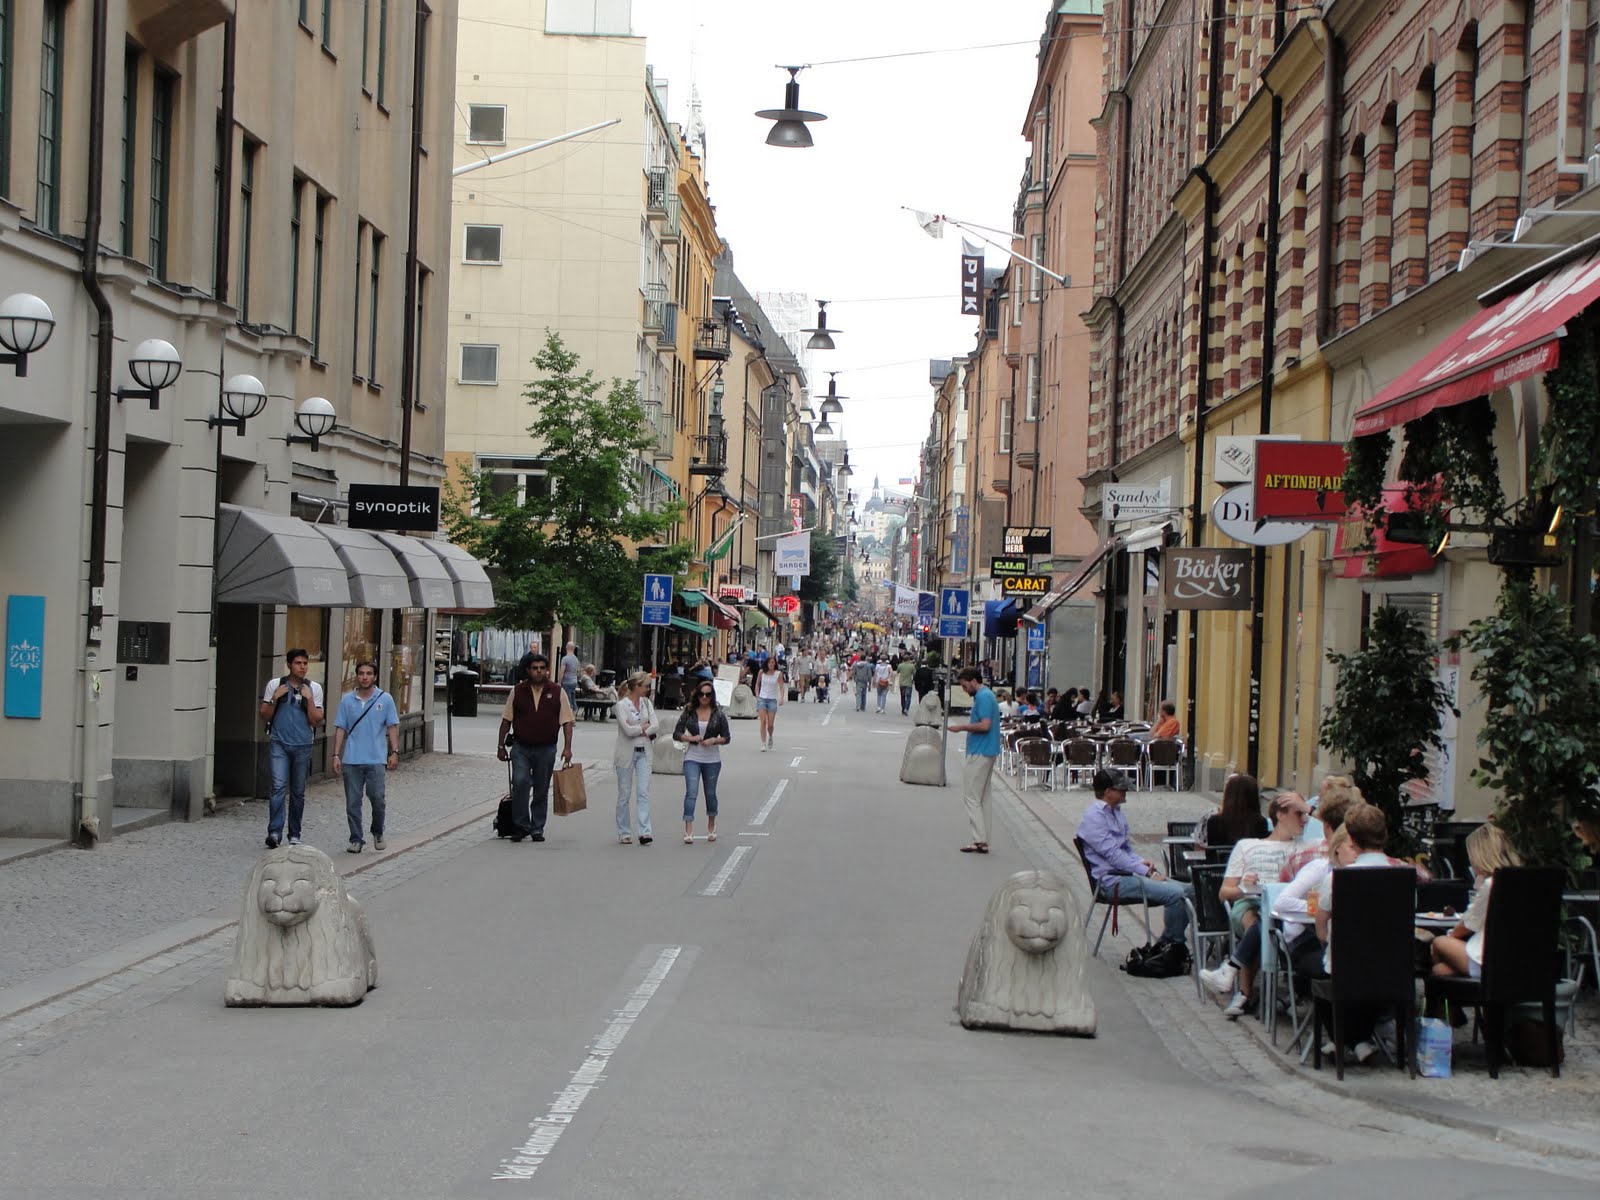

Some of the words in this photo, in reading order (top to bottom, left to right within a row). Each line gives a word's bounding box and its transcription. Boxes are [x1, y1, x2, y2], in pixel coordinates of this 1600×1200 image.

[964, 259, 978, 312] PTK
[1265, 474, 1342, 490] AFTONBLAD
[355, 500, 431, 515] synoptik
[1005, 536, 1023, 545] DAM
[1005, 544, 1024, 553] HERR
[1173, 554, 1244, 588] Böcker
[1004, 577, 1047, 590] CARAT
[721, 587, 744, 599] CHINA
